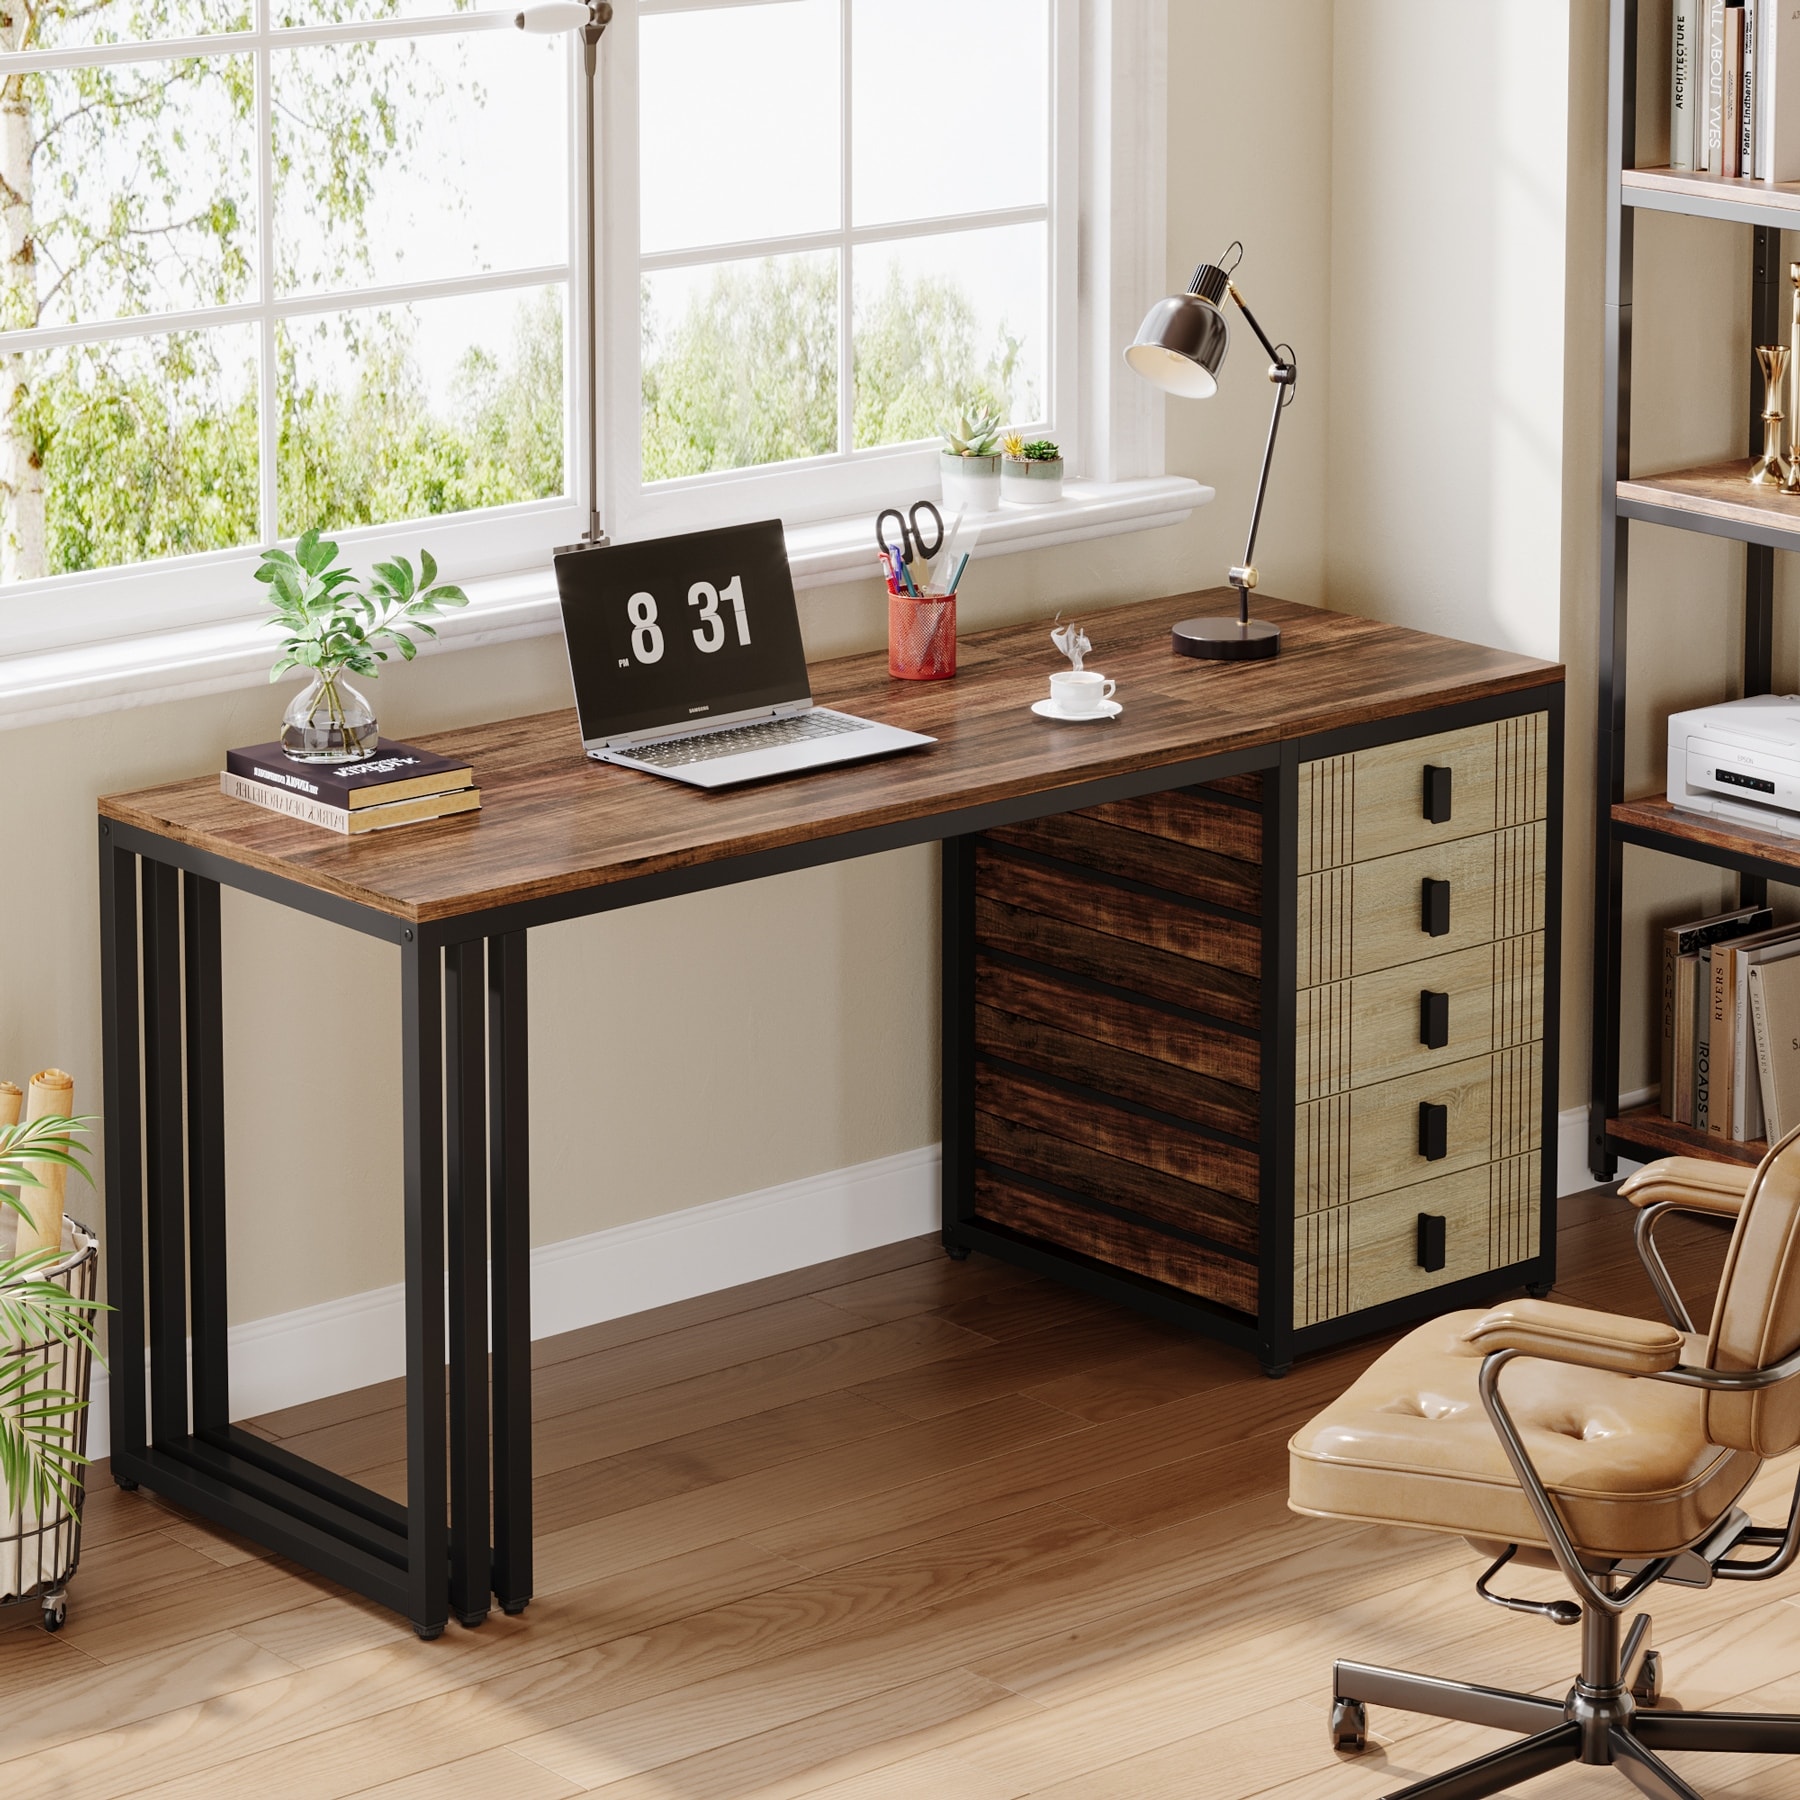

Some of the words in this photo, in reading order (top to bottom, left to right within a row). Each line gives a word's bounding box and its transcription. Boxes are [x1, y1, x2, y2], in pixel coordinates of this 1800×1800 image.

[1711, 0, 1723, 27] ALL
[1675, 15, 1685, 109] ARCHITECTURE
[1709, 34, 1722, 97] ABOUT
[1709, 104, 1721, 149] YVES
[627, 592, 665, 665] 8
[687, 575, 752, 654] 31
[618, 658, 630, 668] PM
[688, 705, 709, 713] SAMSUNG
[1664, 948, 1673, 1038] RAPHAEL
[1715, 966, 1724, 1021] RIVERS
